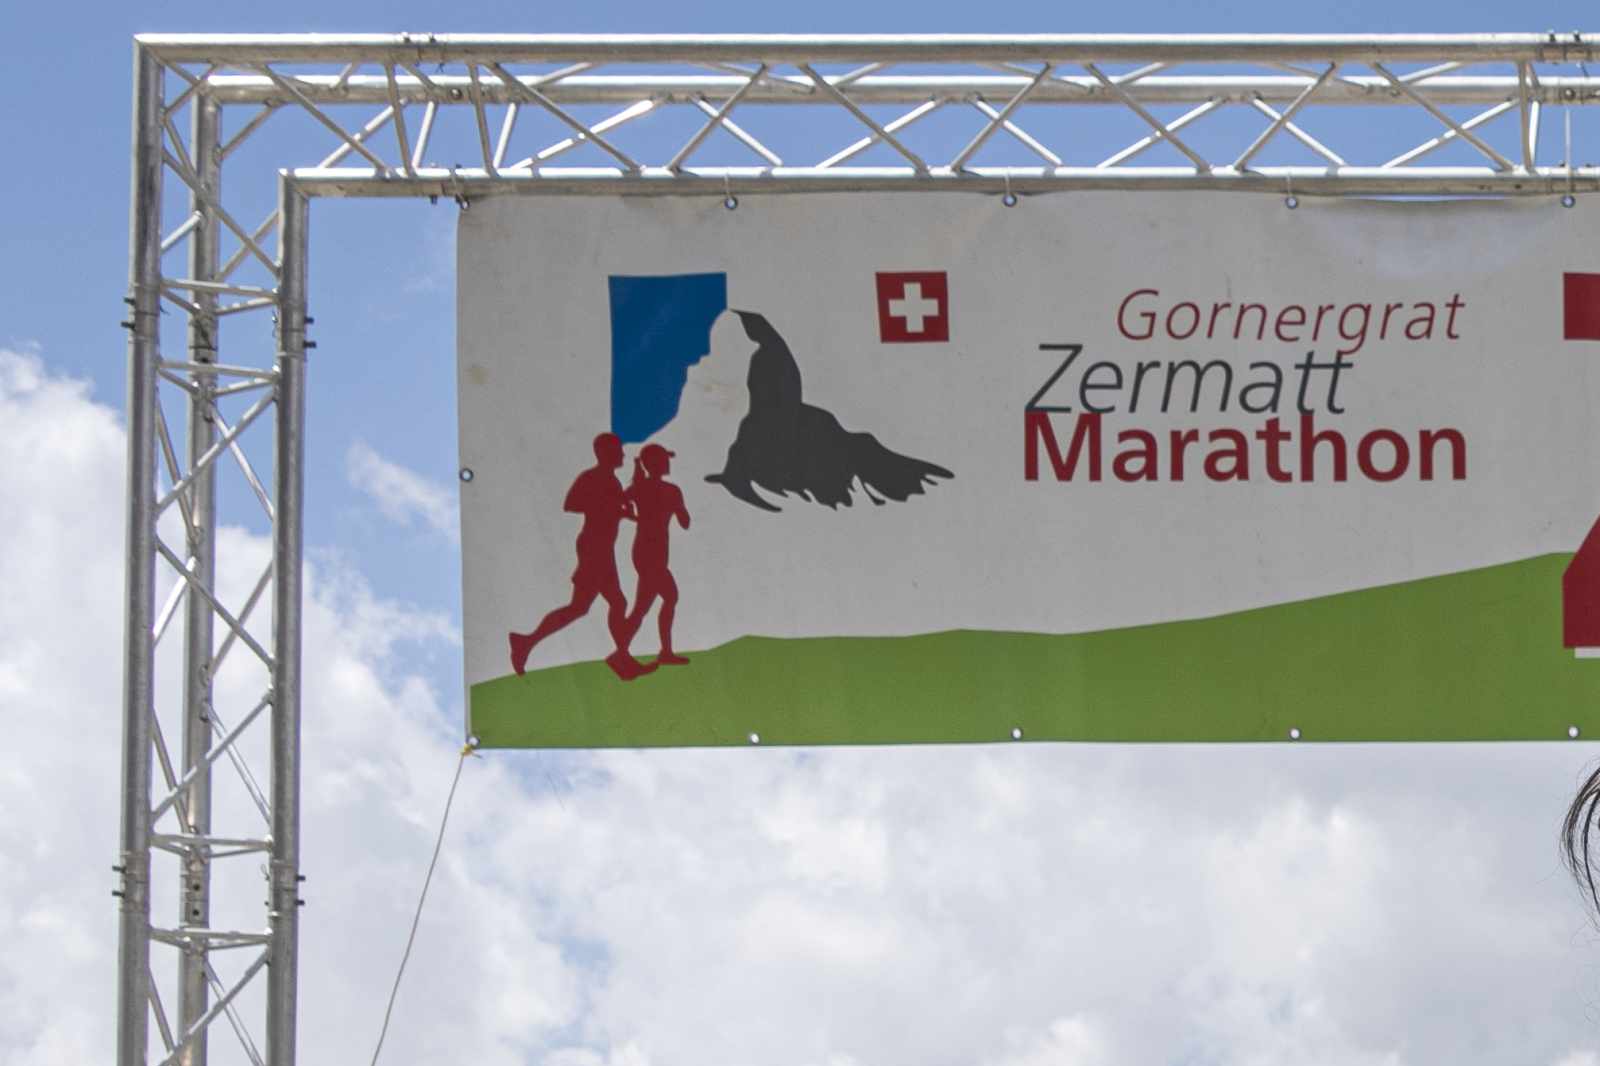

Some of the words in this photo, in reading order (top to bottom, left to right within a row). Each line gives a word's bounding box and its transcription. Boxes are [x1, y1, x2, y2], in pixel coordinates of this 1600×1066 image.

[1117, 288, 1466, 355] Gornergrat
[1024, 343, 1354, 415] Zermatt
[1024, 410, 1467, 483] Marathon
